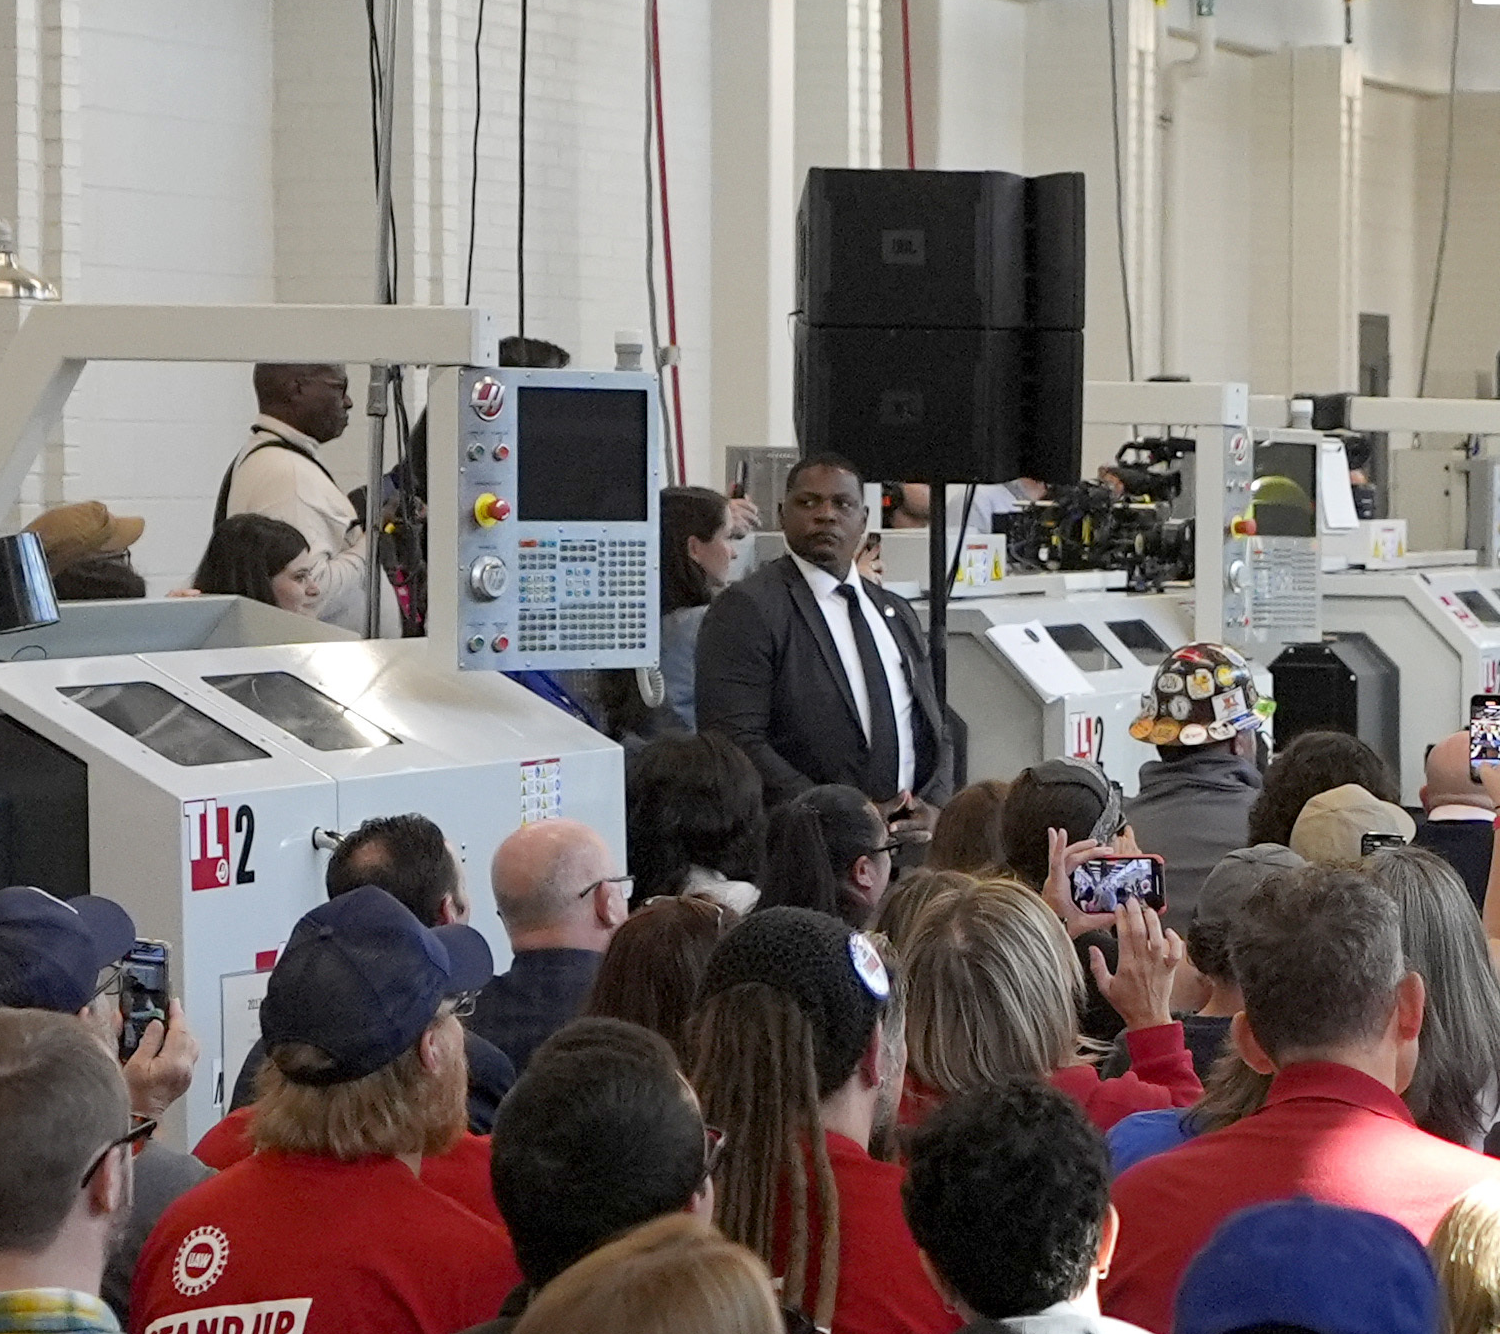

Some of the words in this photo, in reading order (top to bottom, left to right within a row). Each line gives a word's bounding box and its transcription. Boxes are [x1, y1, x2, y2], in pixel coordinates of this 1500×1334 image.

[183, 798, 224, 861] TL
[235, 804, 255, 884] 2
[187, 1252, 212, 1269] UAW
